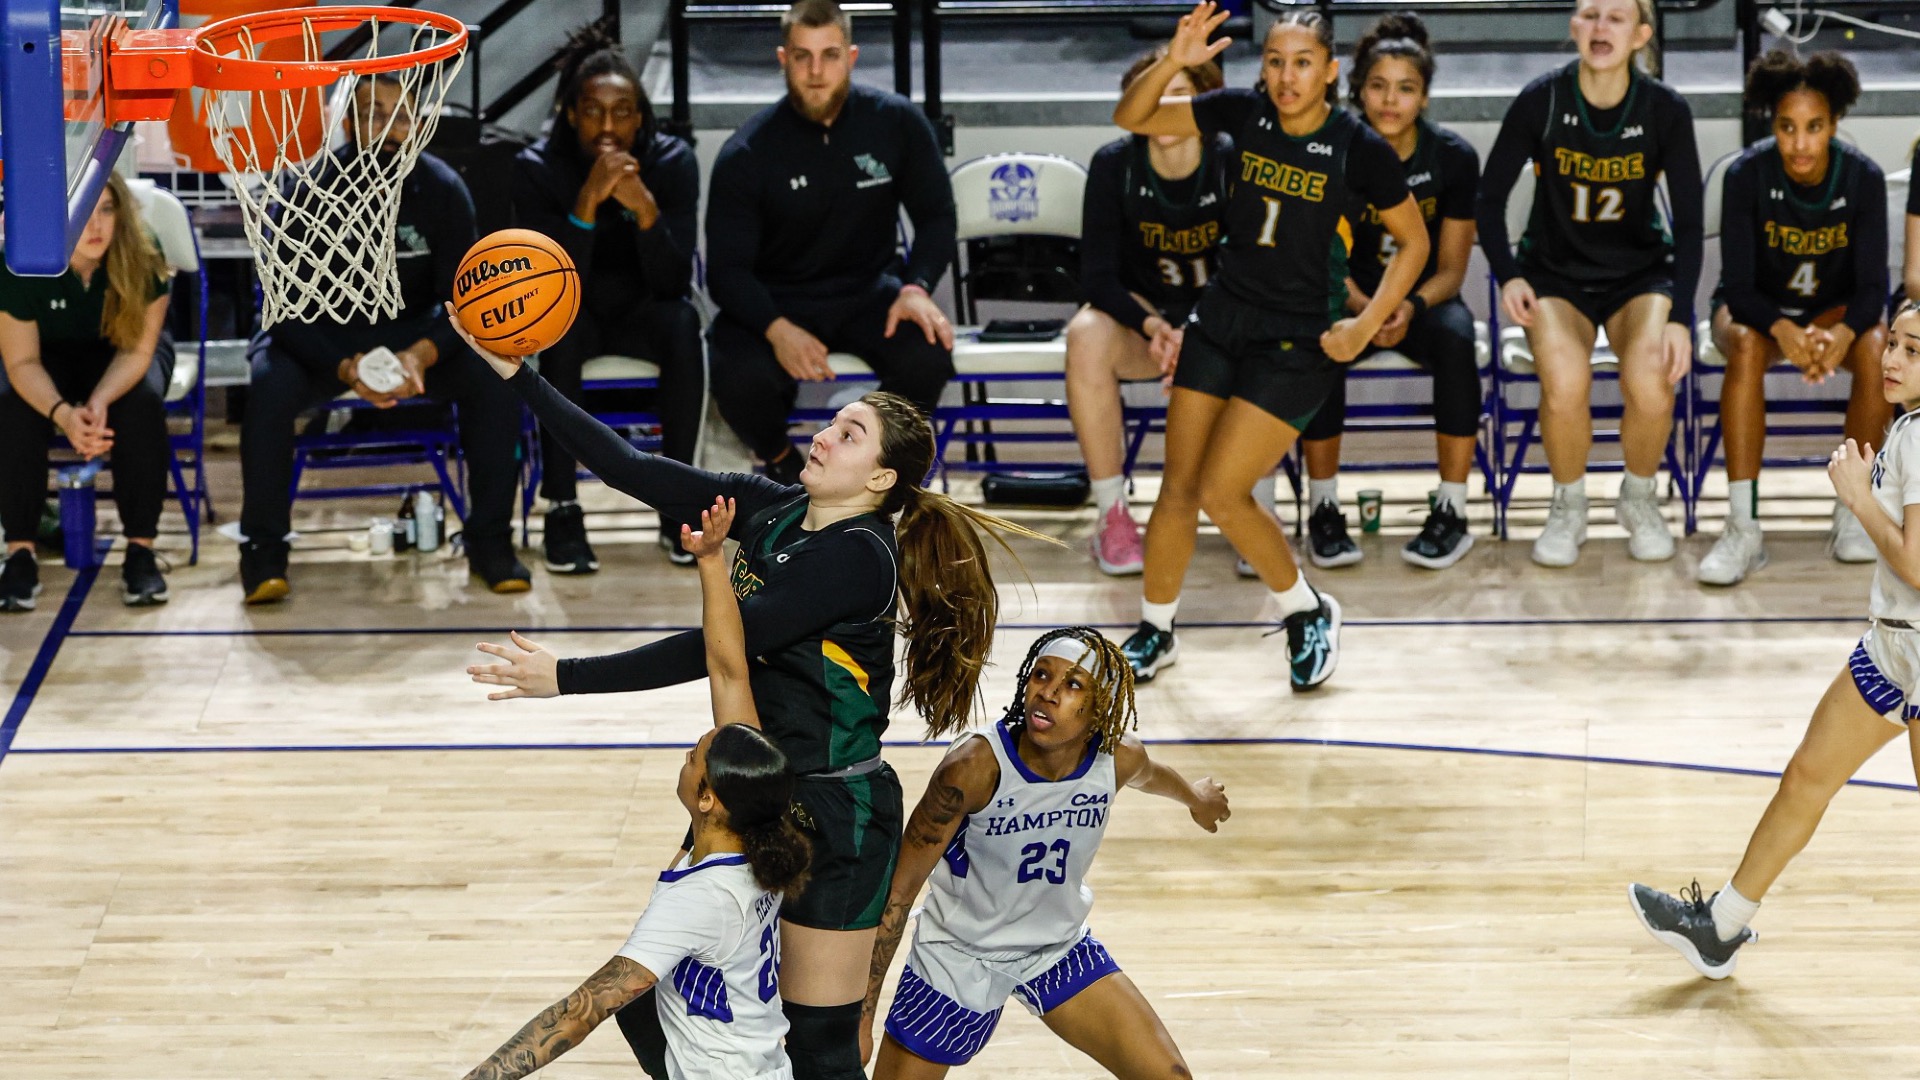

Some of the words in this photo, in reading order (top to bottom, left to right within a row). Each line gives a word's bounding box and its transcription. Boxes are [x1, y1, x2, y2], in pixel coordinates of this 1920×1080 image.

[1241, 151, 1328, 202] TRIBE
[1554, 147, 1645, 182] TRIBE
[1570, 182, 1625, 222] 12
[1139, 221, 1218, 254] TRIBE
[1257, 196, 1281, 247] 1
[1764, 220, 1848, 255] TRIBE
[1377, 233, 1398, 265] 5
[457, 257, 533, 298] Wilson
[1159, 258, 1207, 288] 31
[1787, 261, 1820, 296] 4
[481, 297, 524, 329] EVO
[523, 288, 540, 301] NXT
[1071, 793, 1108, 806] CAA
[985, 806, 1107, 836] HAMPTON
[1017, 838, 1071, 885] 23
